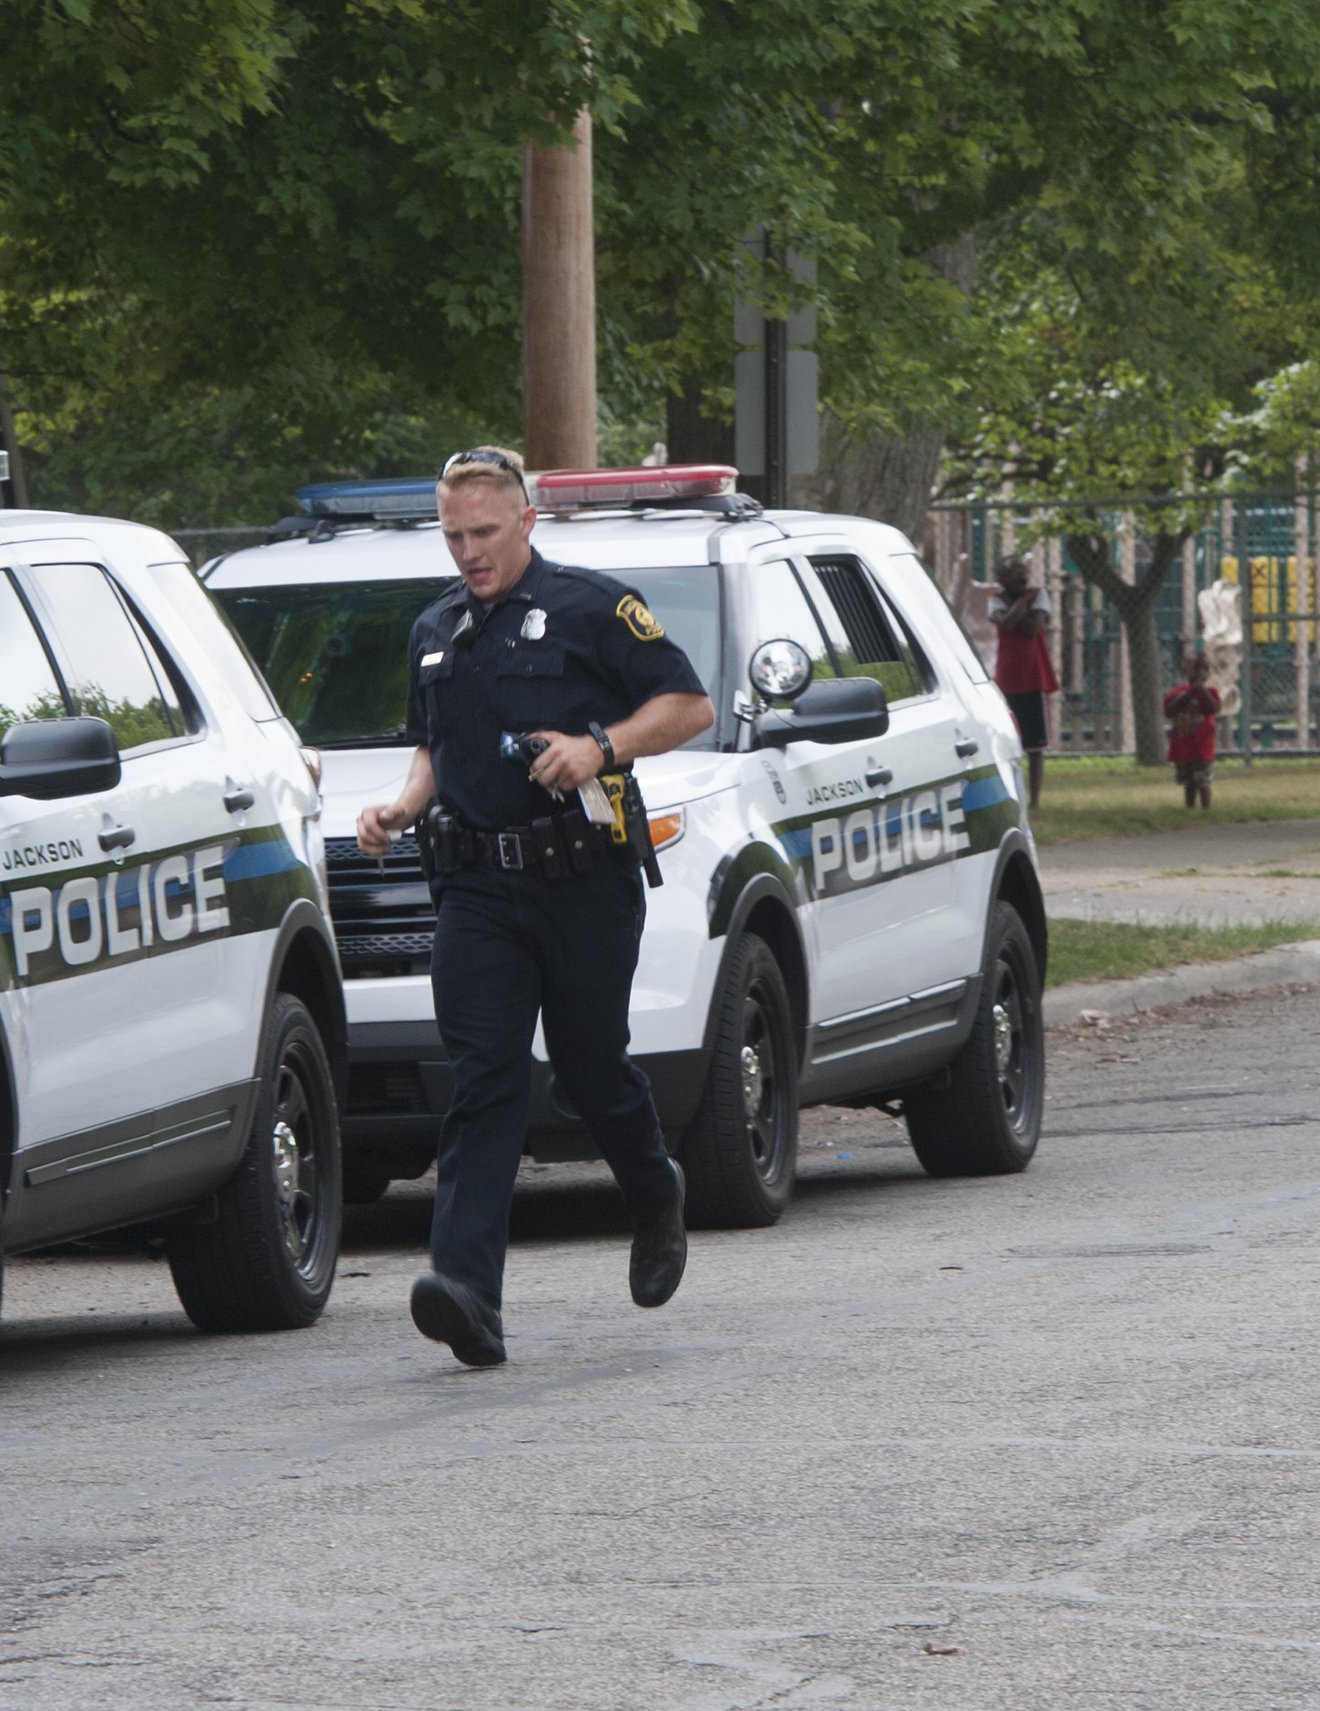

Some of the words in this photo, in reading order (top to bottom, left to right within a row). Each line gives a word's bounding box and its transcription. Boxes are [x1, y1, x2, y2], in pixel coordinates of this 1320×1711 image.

[807, 779, 863, 806] JACKSON
[2, 839, 84, 870] JACKSON
[812, 782, 970, 890] POLICE
[10, 846, 230, 976] POLICE
